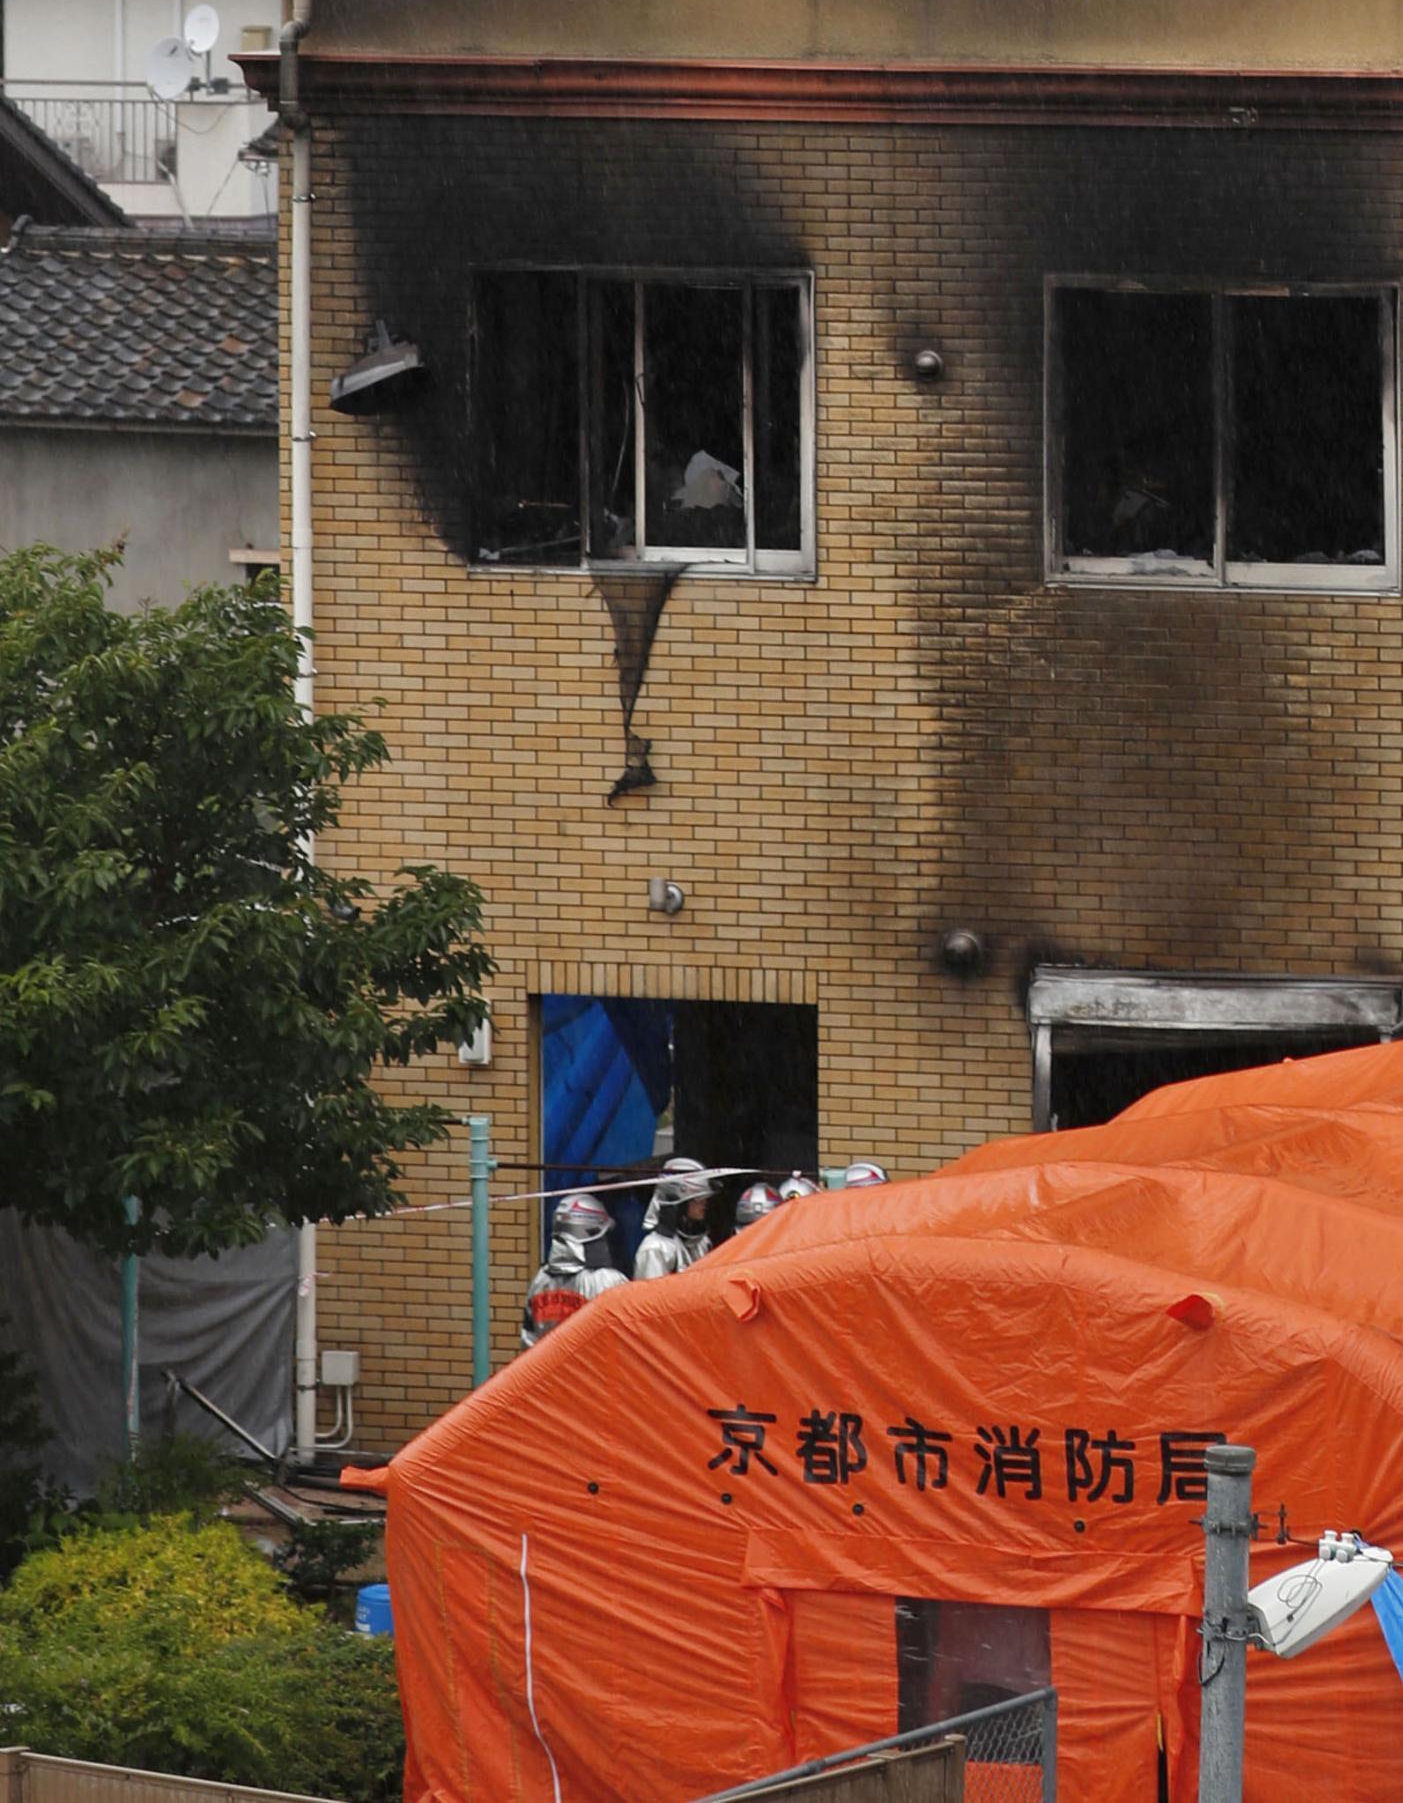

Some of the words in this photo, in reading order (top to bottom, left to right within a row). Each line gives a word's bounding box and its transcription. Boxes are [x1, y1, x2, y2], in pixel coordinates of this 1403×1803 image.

[706, 1403, 1227, 1506] 京都市消防局
